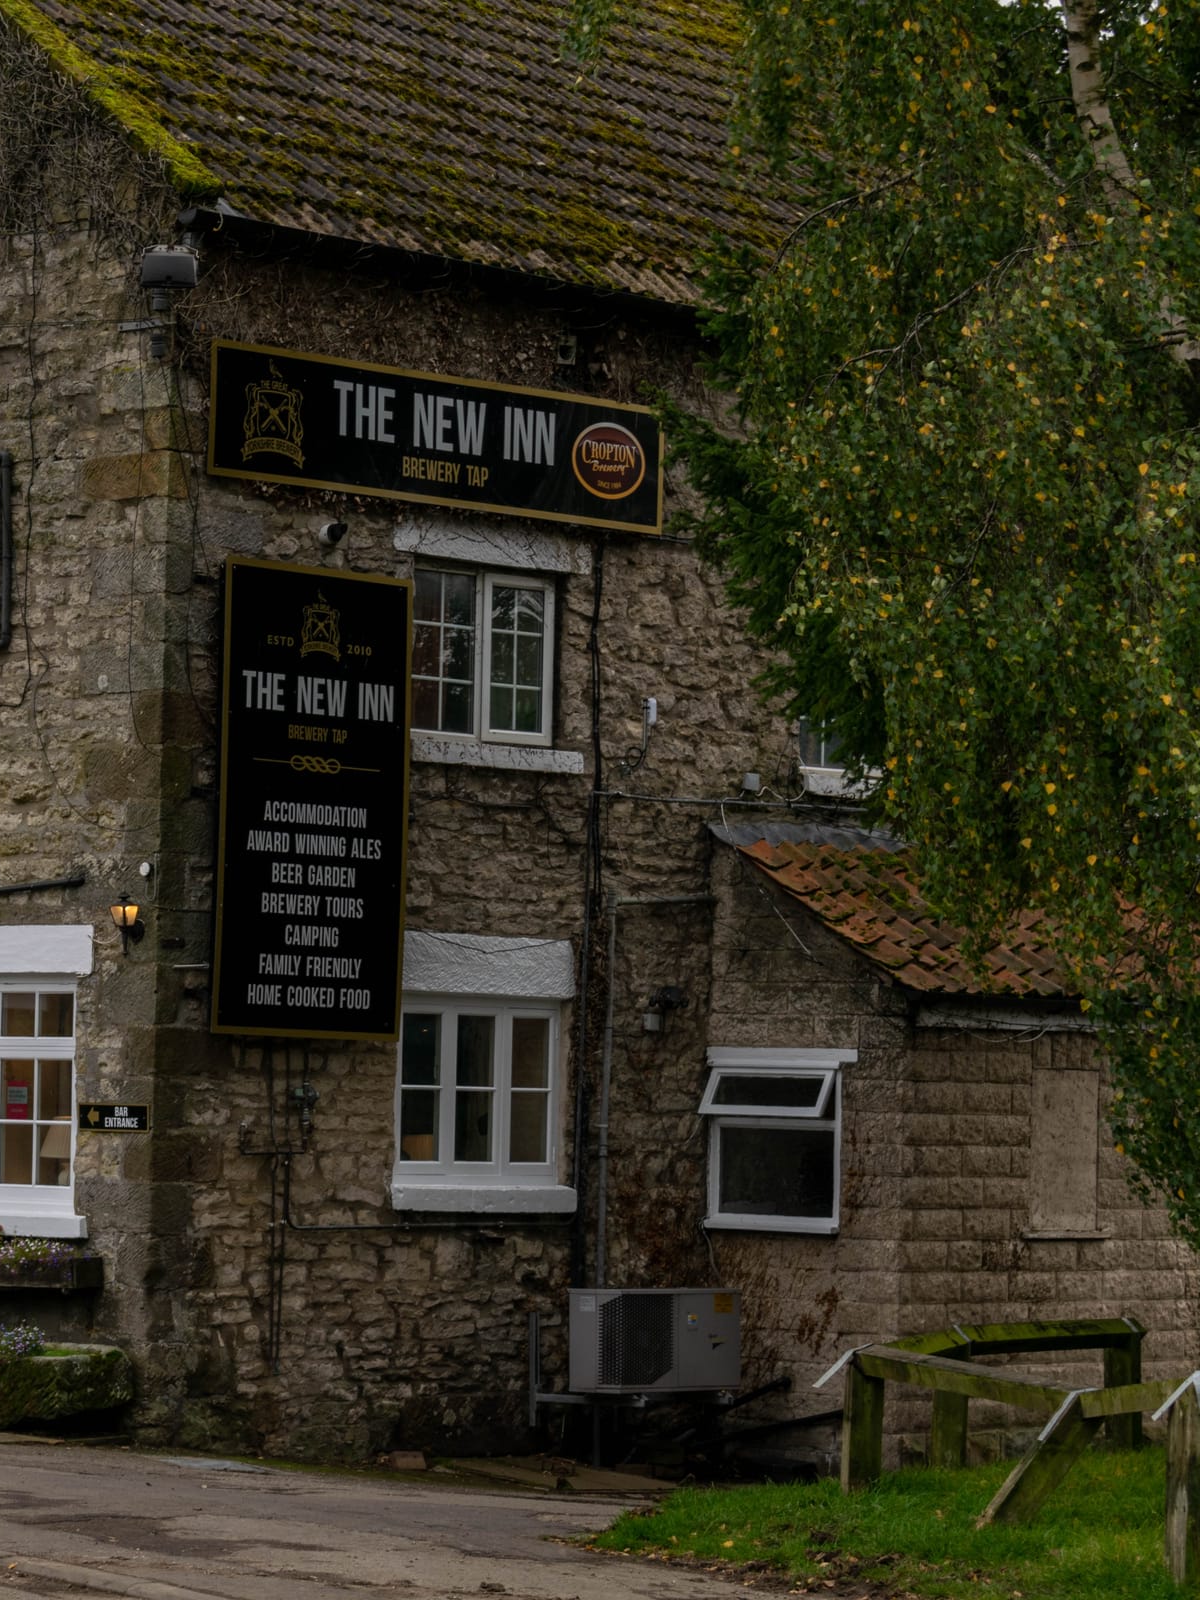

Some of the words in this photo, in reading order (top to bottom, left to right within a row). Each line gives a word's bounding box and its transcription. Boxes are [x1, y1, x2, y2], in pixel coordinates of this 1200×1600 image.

[333, 379, 397, 444] THE
[413, 392, 486, 456] NEW
[503, 405, 556, 466] INN
[581, 439, 637, 469] CROPTON
[402, 455, 461, 484] BREWERY
[466, 464, 489, 488] TAP
[591, 459, 626, 476] Brewery
[267, 634, 295, 647] ESTD
[347, 644, 372, 656] 2010
[242, 669, 286, 712] THE
[296, 675, 348, 718] NEW
[357, 682, 395, 723] INN
[287, 724, 329, 743] BREWERY
[332, 729, 348, 744] TAP
[263, 800, 367, 829] ACCOMMODATION
[246, 830, 290, 853] AWARD
[295, 833, 346, 857] WINNING
[350, 838, 382, 860] ALES
[271, 862, 303, 885] BEER
[307, 865, 356, 888] GARDEN
[261, 892, 321, 916] BREWERY
[325, 896, 364, 919] TOURS
[284, 924, 339, 948] CAMPING
[258, 953, 301, 976] FAMILY
[306, 956, 362, 979] FRIENDLY
[247, 984, 282, 1006] HOME
[287, 986, 335, 1009] COOKED
[339, 989, 371, 1010] FOOD
[104, 1117, 139, 1128] ENTRANCE
[114, 1106, 129, 1117] BAR
